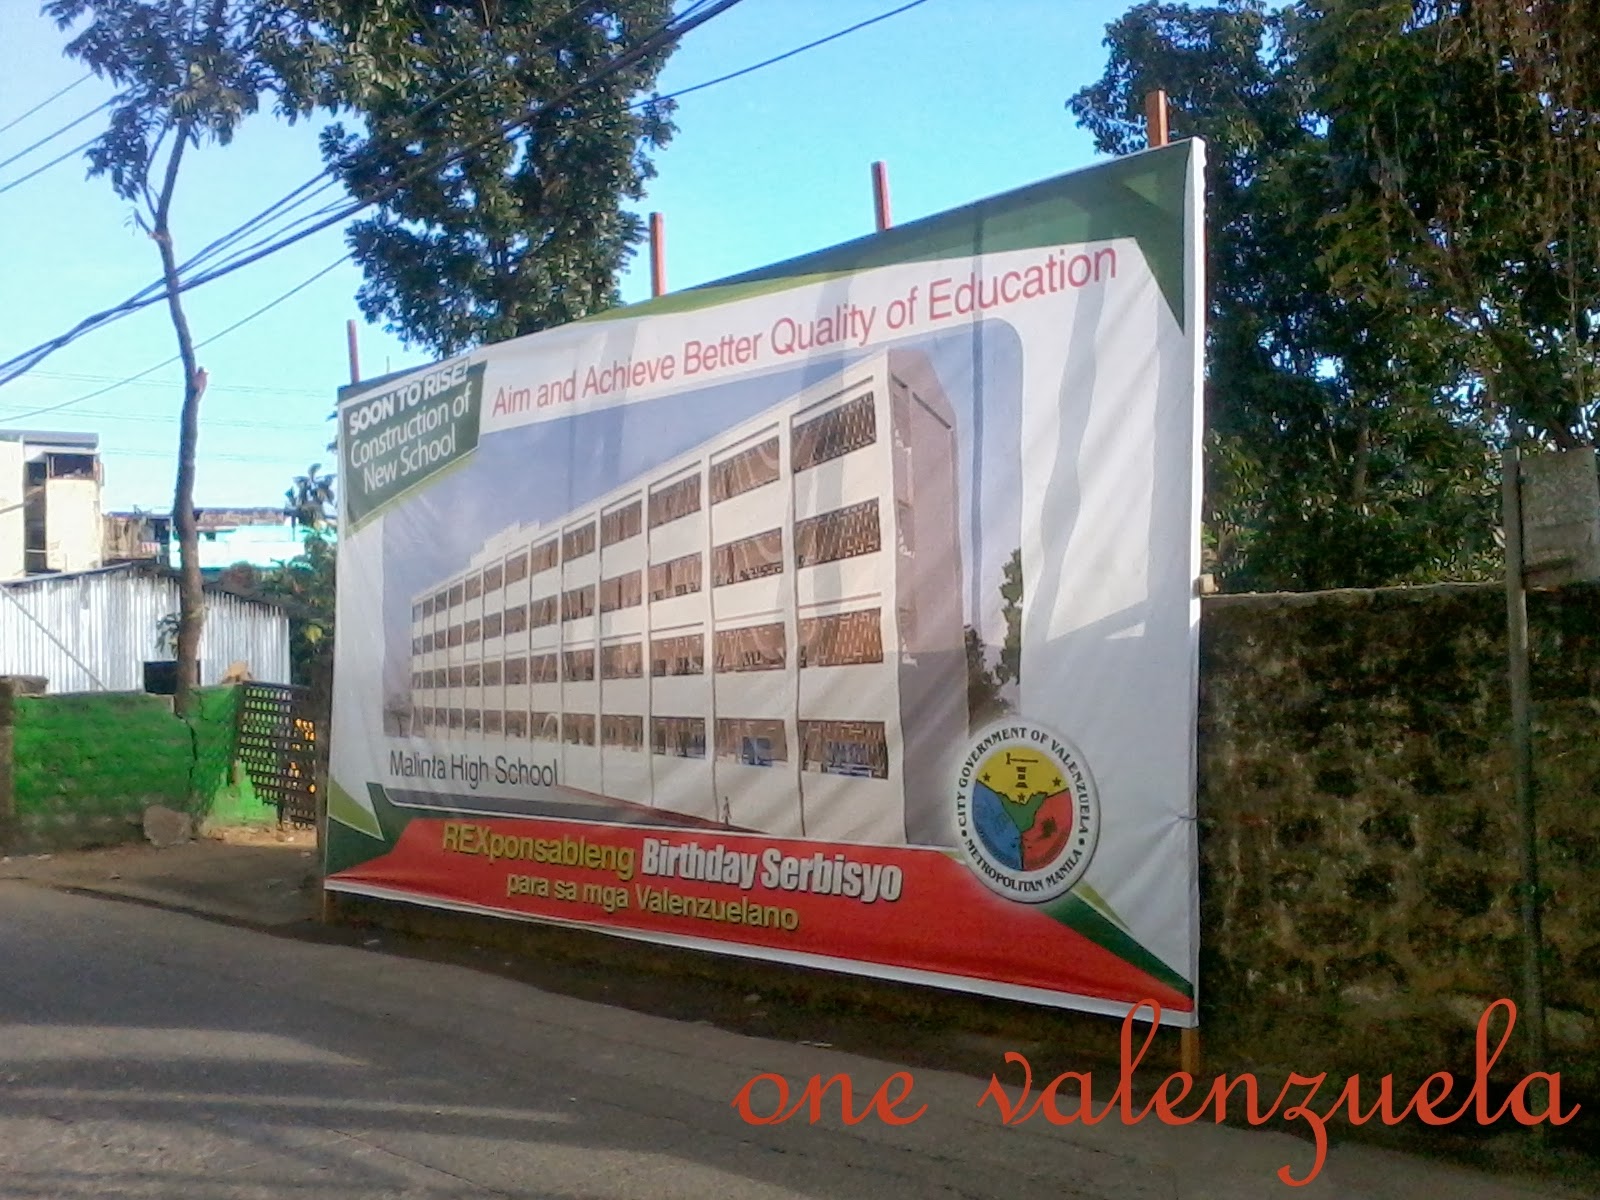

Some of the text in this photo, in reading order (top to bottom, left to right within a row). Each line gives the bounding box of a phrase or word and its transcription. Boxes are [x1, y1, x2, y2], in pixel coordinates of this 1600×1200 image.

[492, 247, 1117, 417] Aim and Achieve Better Quality of Education
[350, 361, 470, 435] SOON TO RISE!
[350, 381, 473, 469] Construction of
[363, 430, 457, 494] New School
[389, 750, 559, 789] Malinta High School
[957, 727, 1090, 834] CITY GOVERNMENT OF VALENZUELA
[442, 823, 903, 902] REXponsableng Birthday Serbisyo
[965, 838, 1082, 892] METROPOLITAN MANILA
[506, 873, 800, 931] para sa mga Valenzuelano
